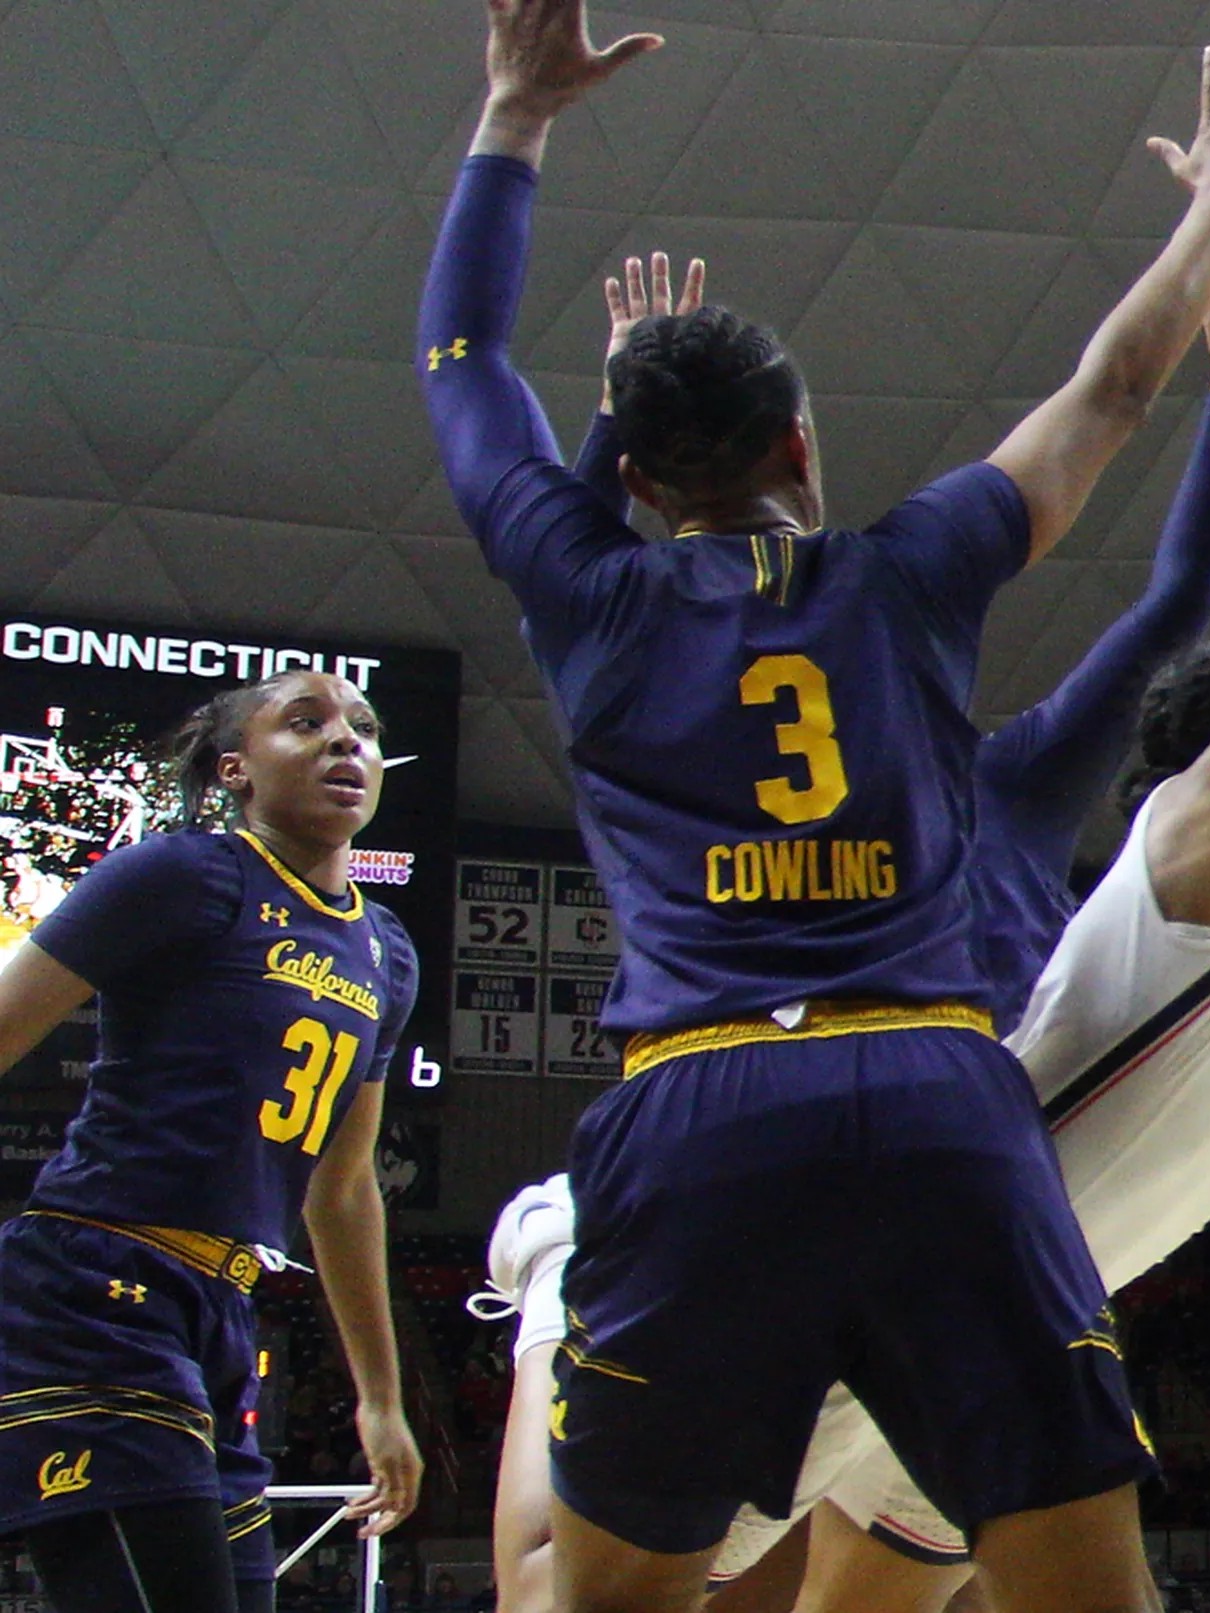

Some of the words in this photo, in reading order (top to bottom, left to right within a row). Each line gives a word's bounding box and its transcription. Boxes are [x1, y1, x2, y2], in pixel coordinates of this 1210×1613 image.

[739, 653, 849, 825] 3
[347, 866, 408, 882] ONUTS
[348, 850, 415, 867] UNKIN'
[706, 839, 897, 904] COWLING
[469, 906, 529, 944] 52
[263, 939, 380, 1021] California
[480, 1015, 511, 1053] 15
[571, 1019, 605, 1057] 22
[258, 1016, 360, 1156] 31
[36, 1448, 93, 1500] Cal
